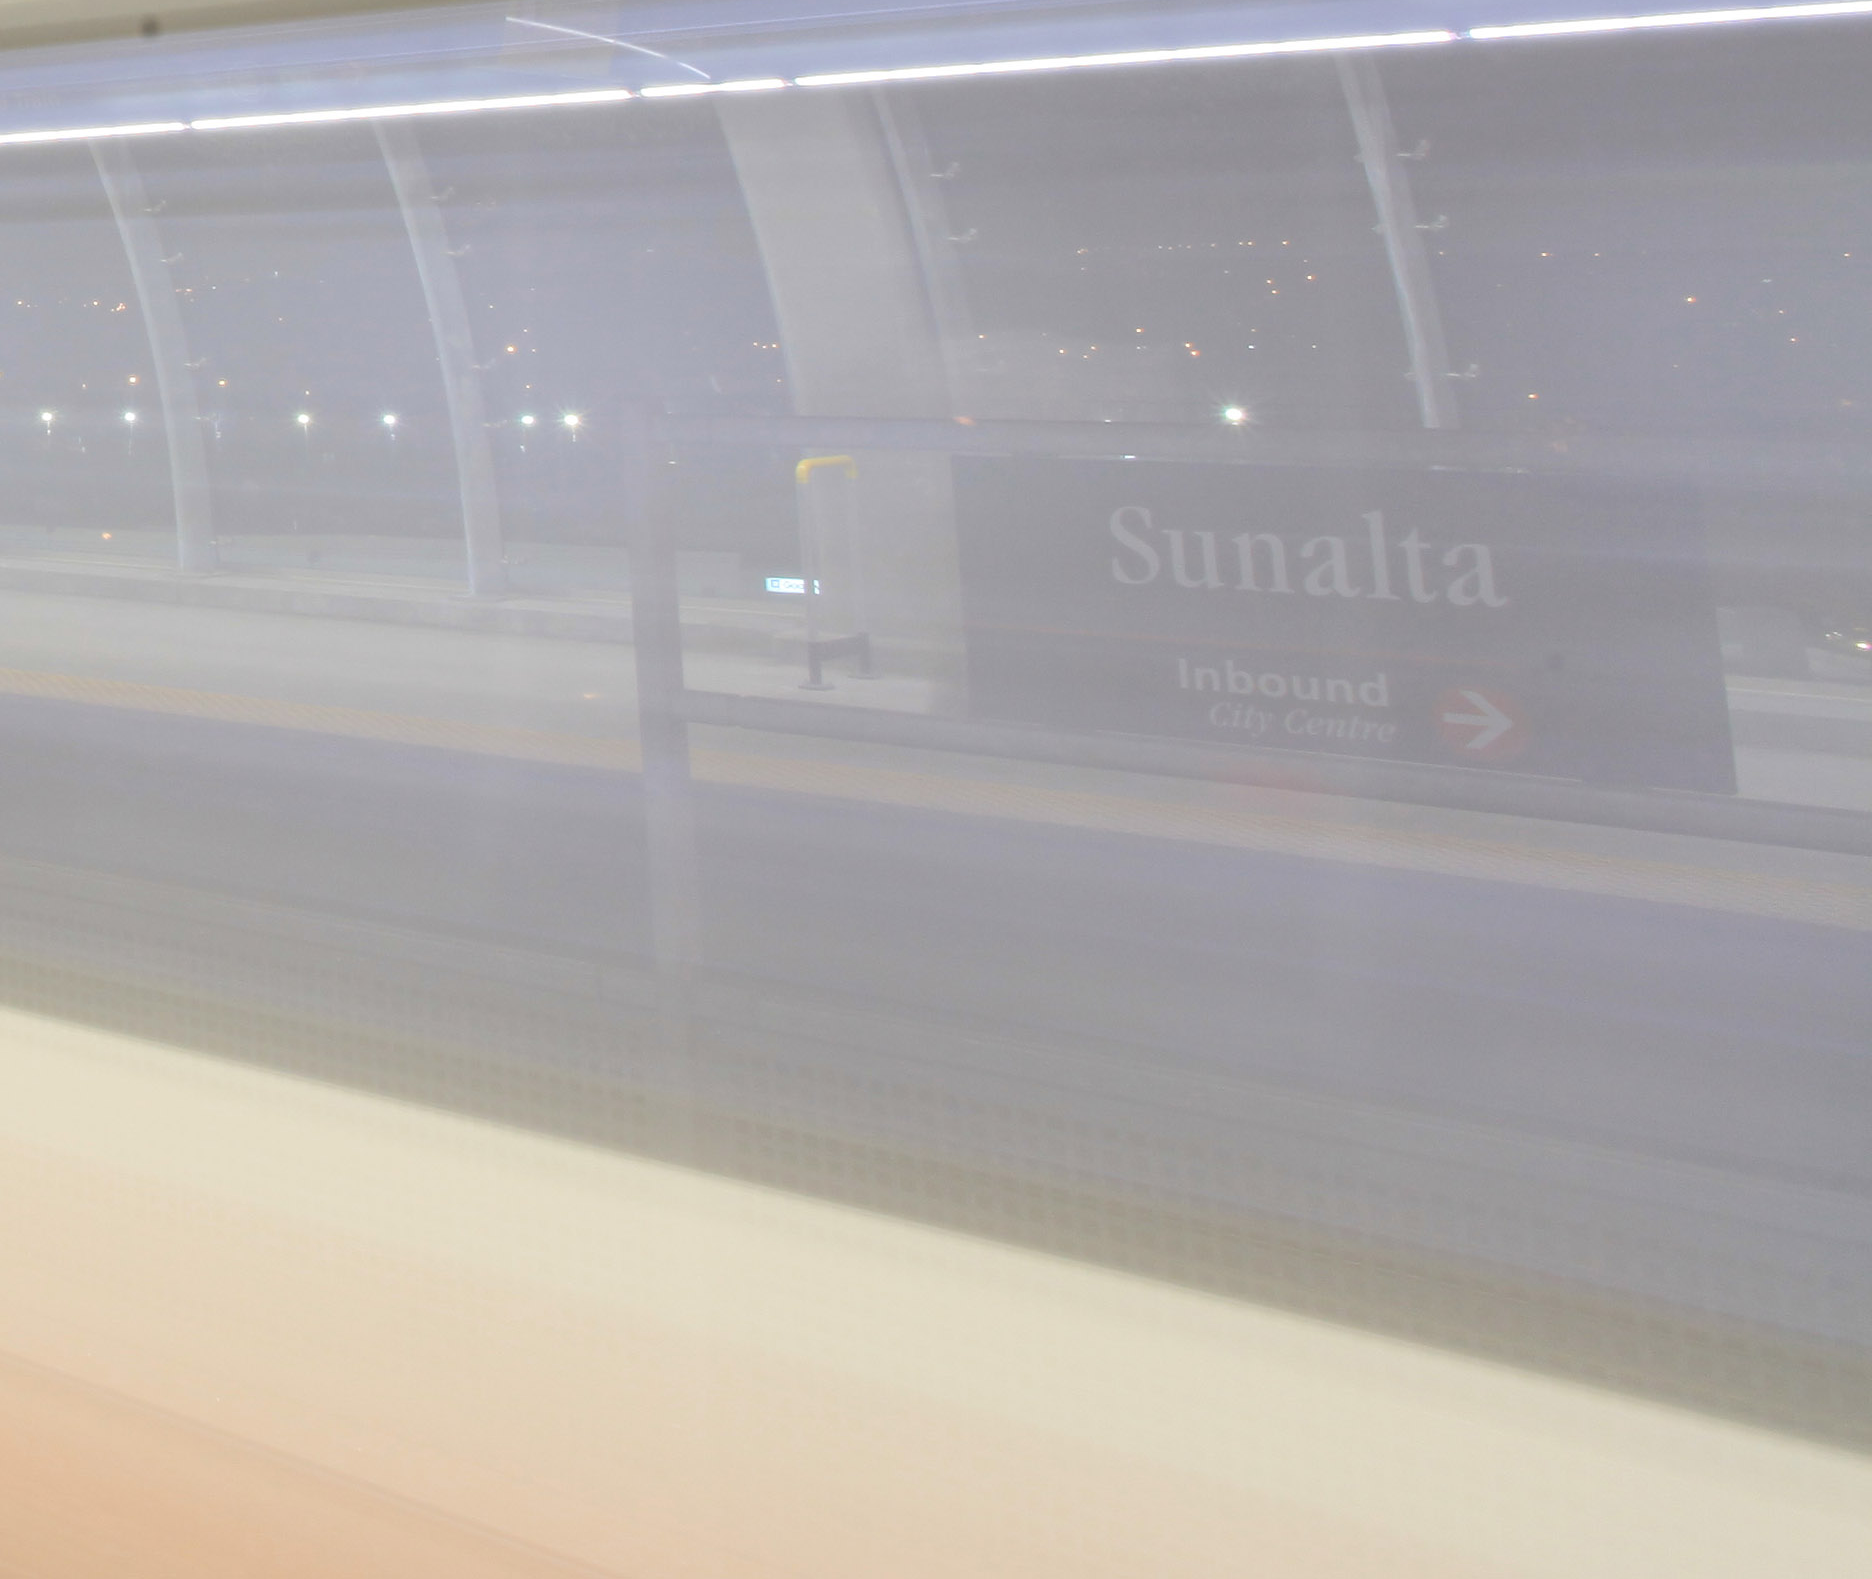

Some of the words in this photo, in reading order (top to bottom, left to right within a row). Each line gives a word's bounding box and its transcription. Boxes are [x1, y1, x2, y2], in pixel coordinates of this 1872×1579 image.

[1108, 505, 1509, 608] Sunalta
[1178, 658, 1389, 708] Inbound
[1209, 701, 1272, 738] City
[1283, 709, 1397, 743] Centre
